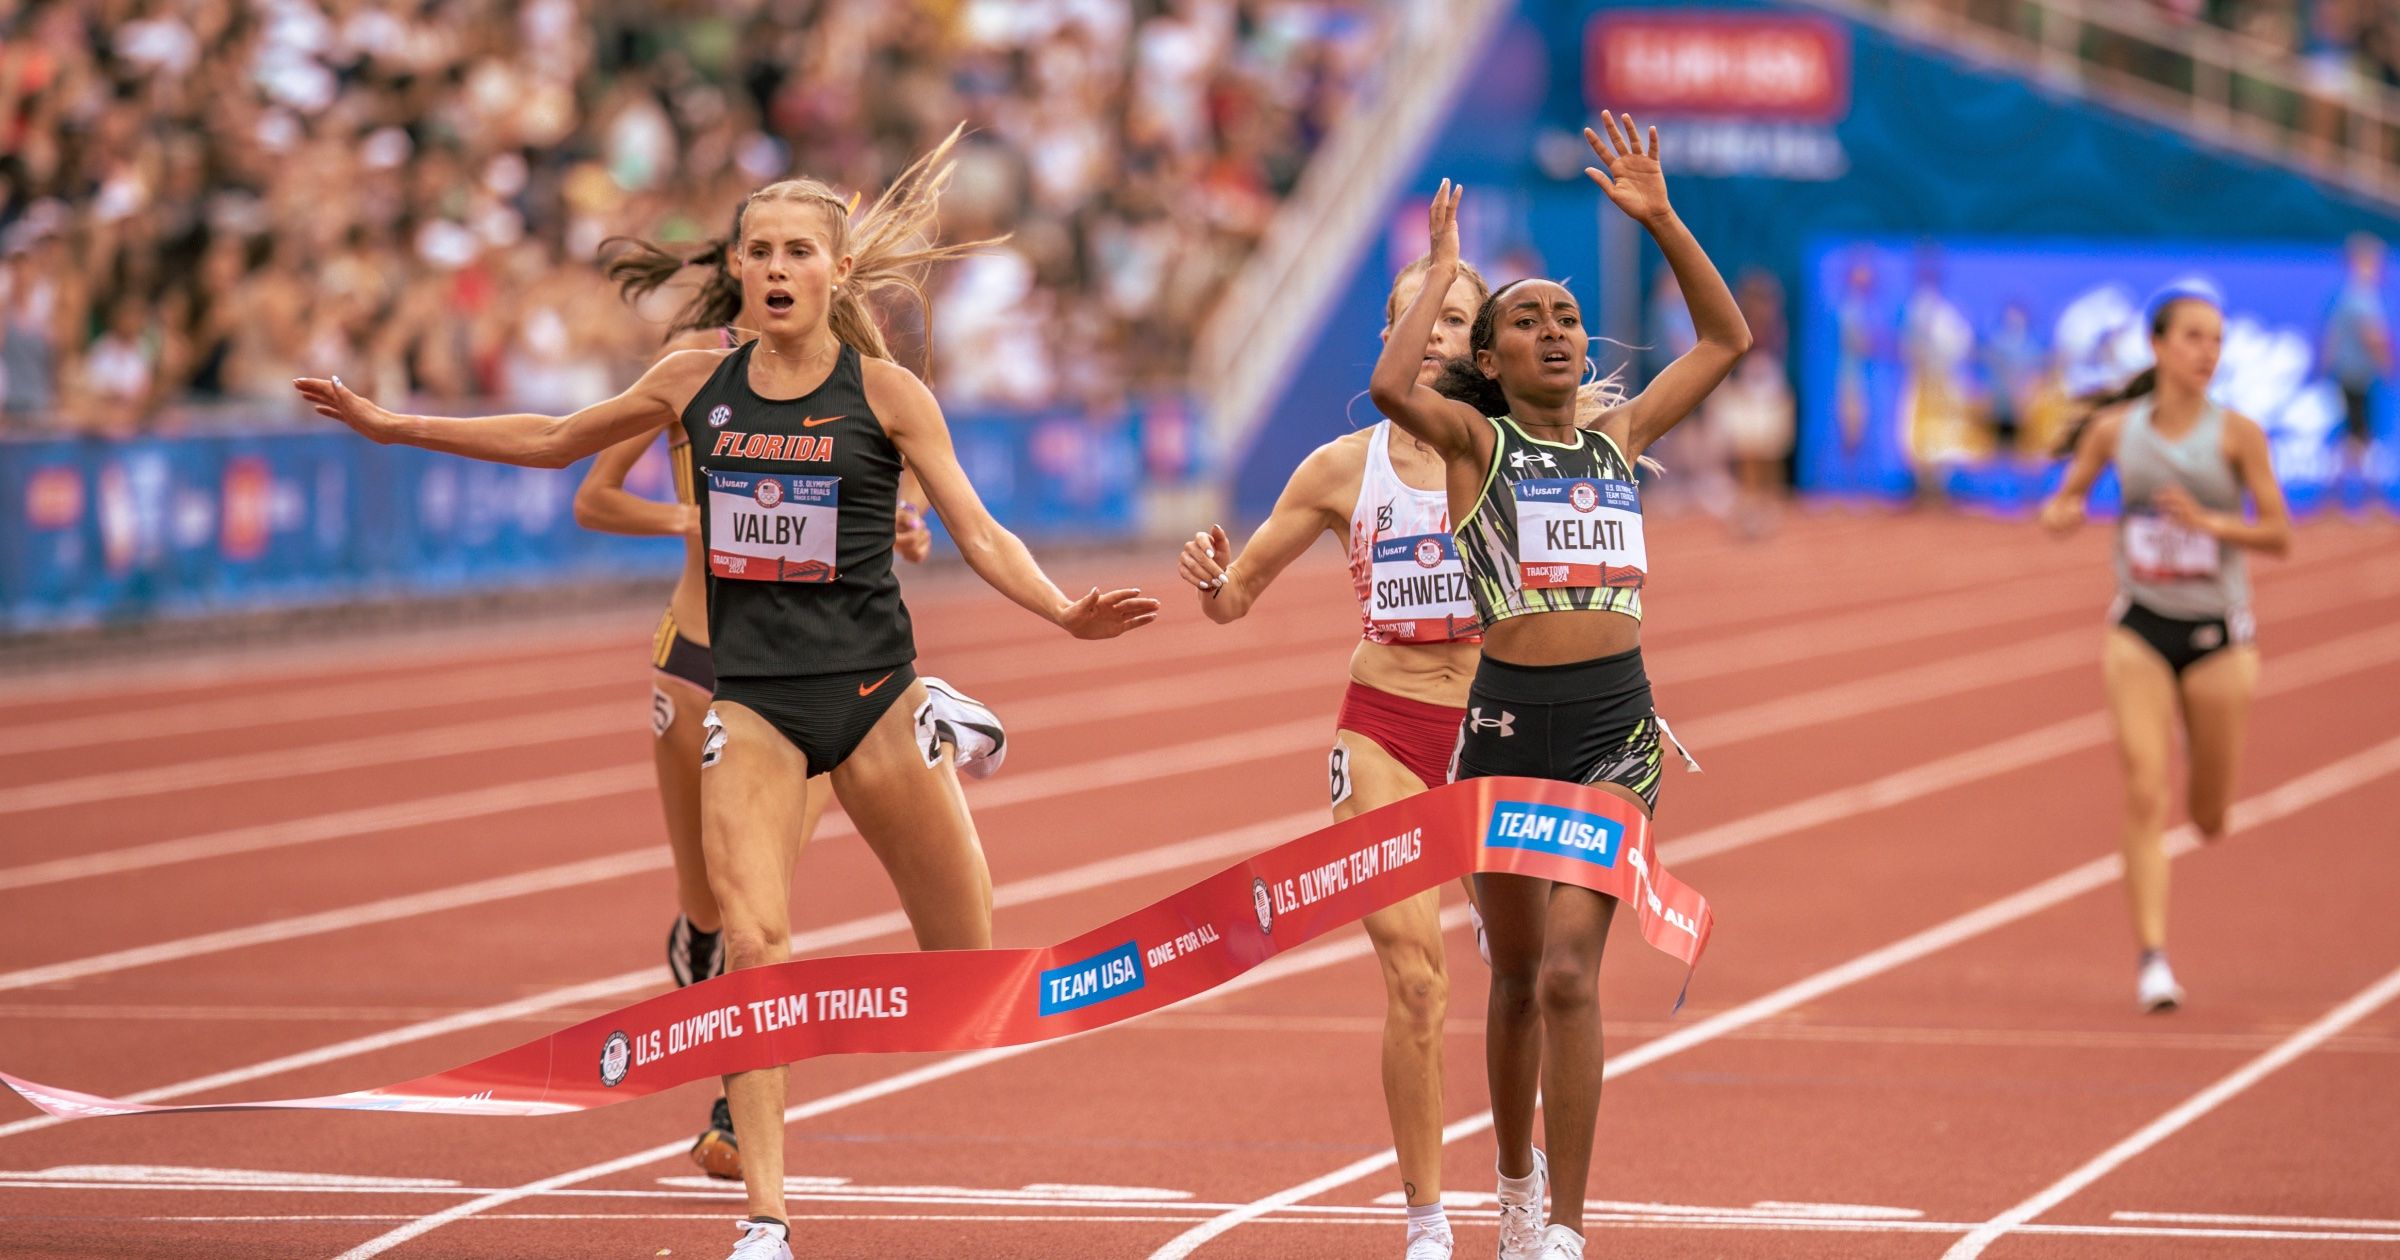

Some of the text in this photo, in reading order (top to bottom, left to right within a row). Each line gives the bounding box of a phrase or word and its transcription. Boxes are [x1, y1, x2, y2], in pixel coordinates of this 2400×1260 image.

[710, 406, 730, 426] SEC
[711, 431, 834, 462] FLORIDA
[725, 480, 749, 489] USATF
[810, 488, 831, 496] TRIALS
[733, 512, 807, 546] VALBY
[1545, 519, 1625, 551] KELATI
[714, 555, 747, 568] TRACKTOWN
[1386, 546, 1408, 556] USATF
[729, 566, 745, 574] 2024
[1526, 565, 1569, 576] TRACKTOWN
[1549, 573, 1568, 583] 2024
[1377, 572, 1471, 610] SCHWEIZ
[1377, 621, 1416, 633] TRACKTOWN
[654, 693, 669, 731] 5
[1331, 749, 1345, 802] 8
[1273, 873, 1299, 916] U.S.
[1299, 857, 1348, 906] OLYMPIC
[1349, 841, 1378, 886] TEAM
[1381, 827, 1422, 871] TRIALS
[1498, 812, 1557, 842] TEAM
[1559, 820, 1609, 854] USA
[1664, 907, 1699, 939] ALL
[1050, 923, 1219, 1004] TEAM USA ONE FOR ALL
[636, 1029, 664, 1066] U.S.
[668, 1005, 743, 1055] OLYMPIC
[748, 993, 809, 1035] TEAM
[815, 986, 909, 1022] TRIALS
